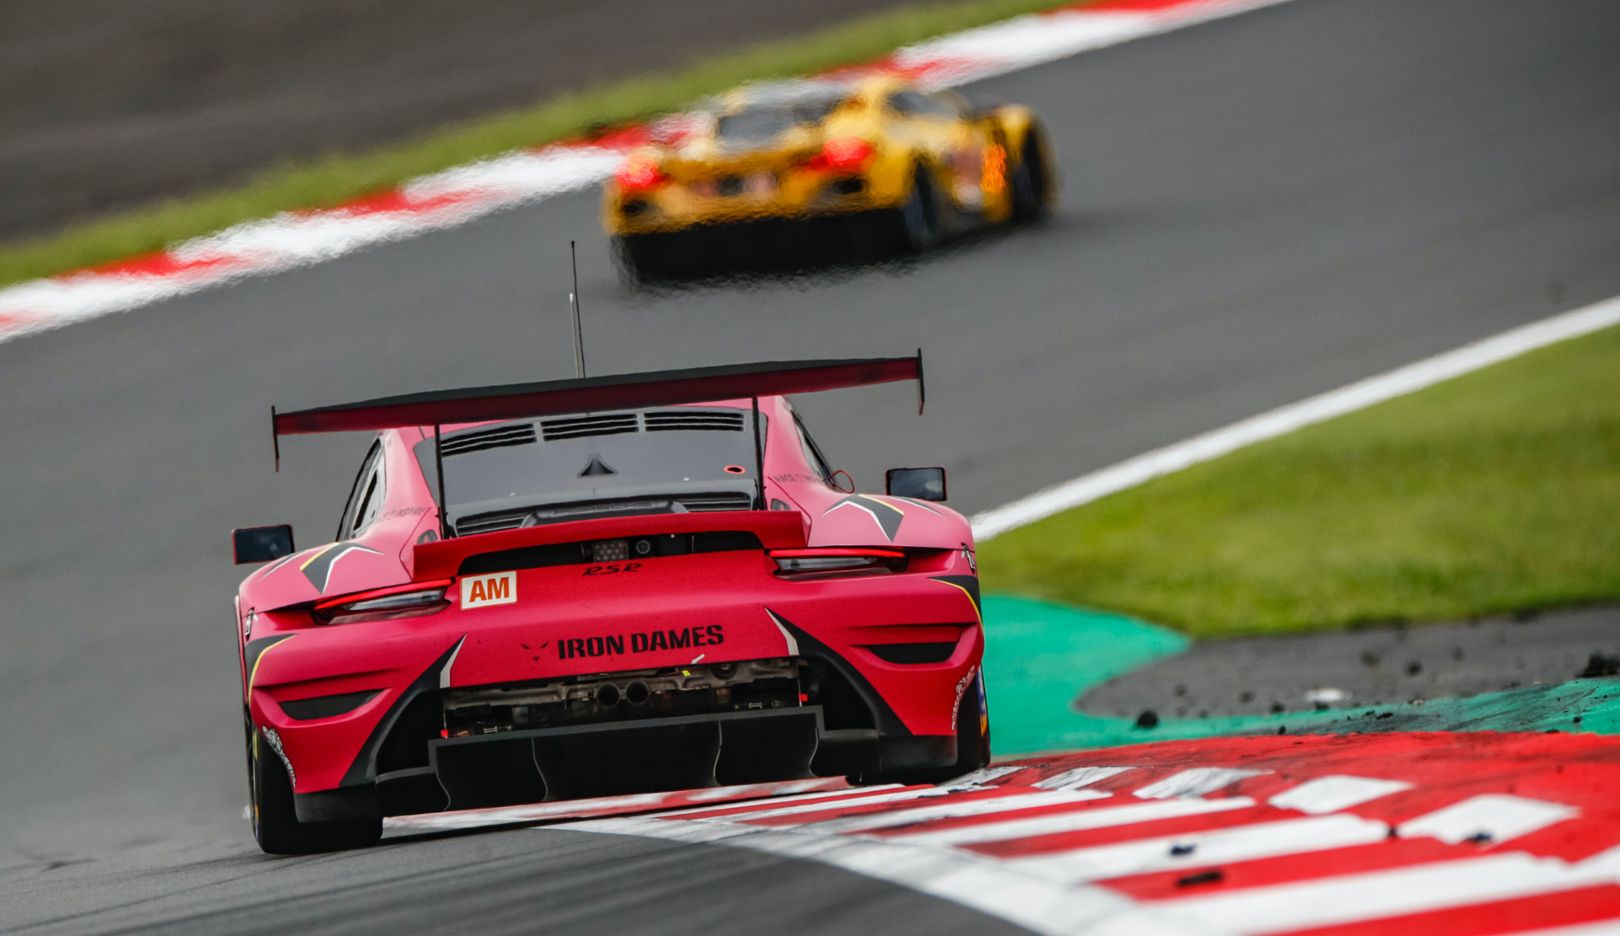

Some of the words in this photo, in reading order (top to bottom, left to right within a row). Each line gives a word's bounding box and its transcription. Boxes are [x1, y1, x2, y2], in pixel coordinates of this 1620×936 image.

[469, 577, 509, 602] AM
[558, 635, 625, 660] IRON
[632, 625, 724, 653] DAMES
